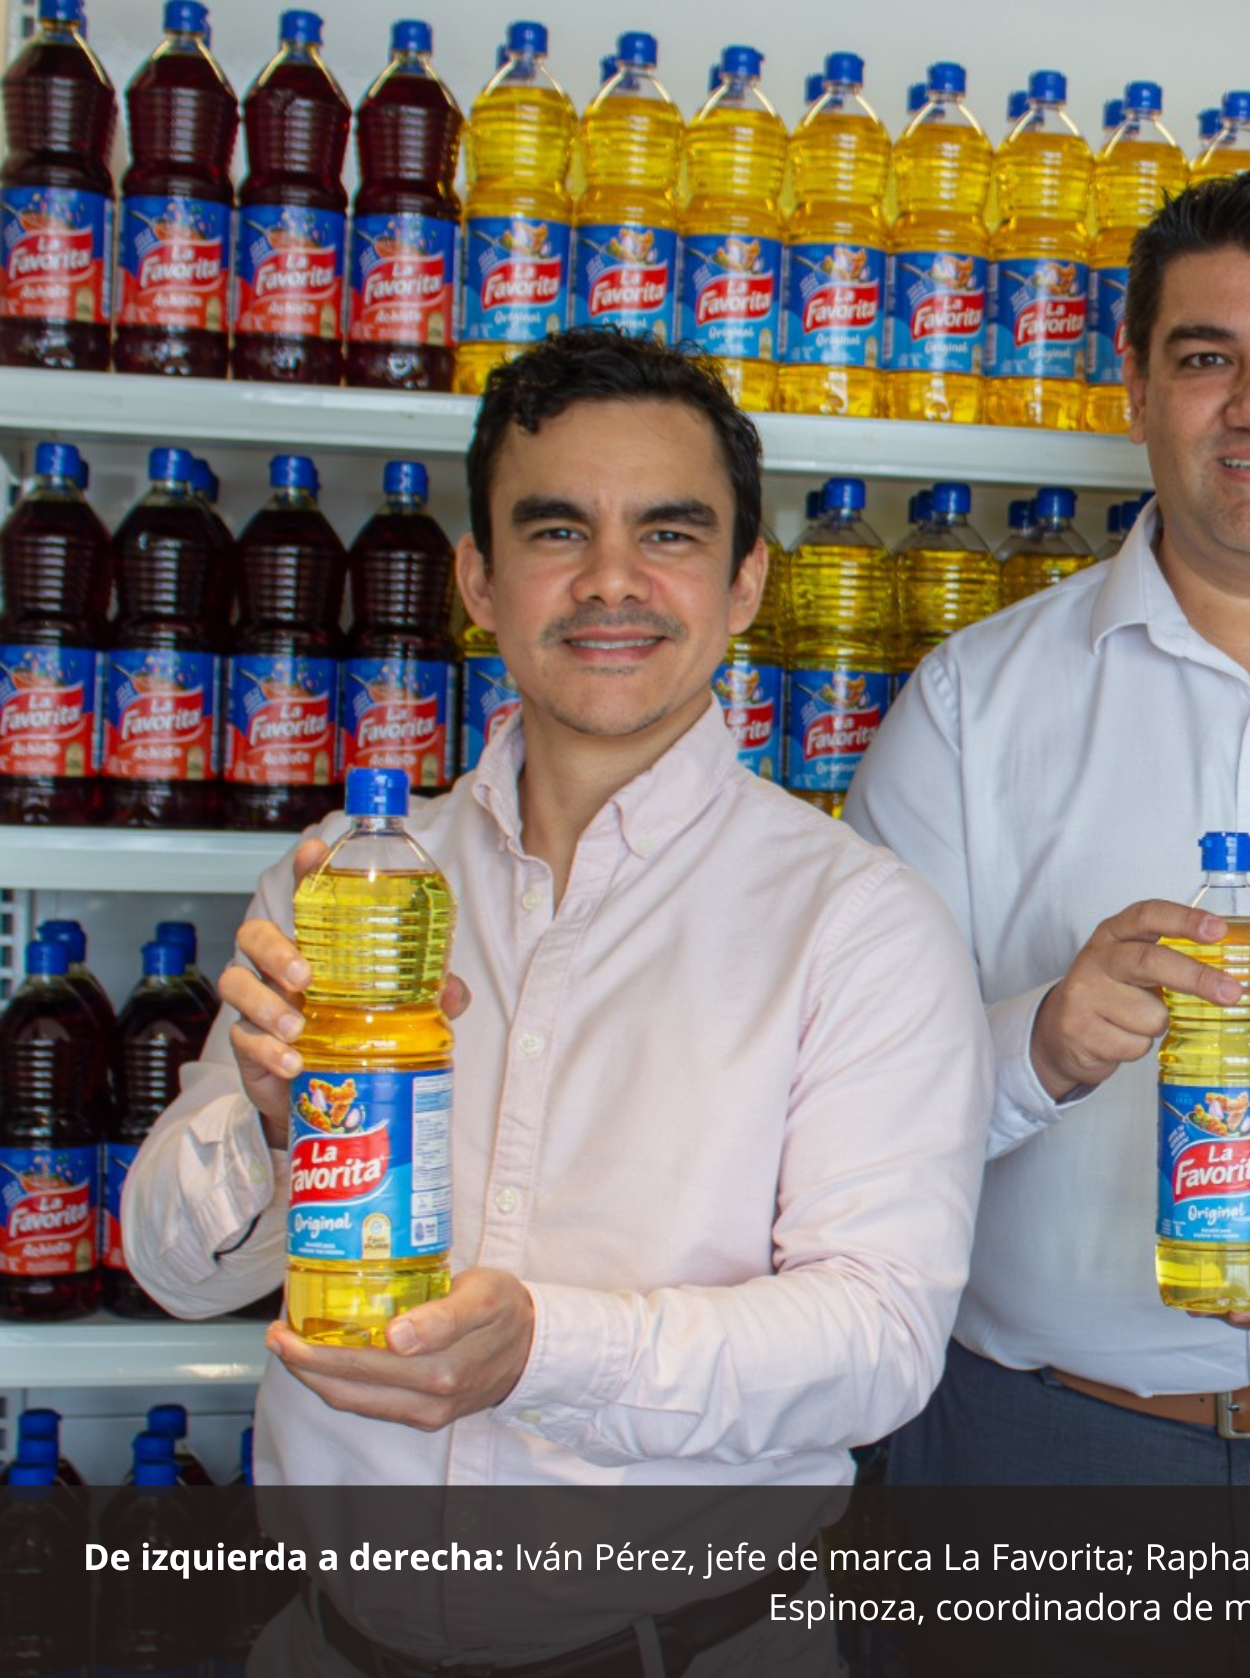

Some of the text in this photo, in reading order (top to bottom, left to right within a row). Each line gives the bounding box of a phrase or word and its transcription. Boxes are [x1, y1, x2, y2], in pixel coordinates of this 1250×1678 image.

[37, 236, 61, 251] La
[171, 244, 195, 260] La
[8, 248, 90, 280] Favorita
[139, 257, 220, 289] Favorita
[286, 254, 308, 270] La
[392, 263, 415, 277] La
[513, 264, 537, 280] La
[256, 267, 334, 297] Favorita
[620, 270, 643, 286] La
[727, 279, 748, 295] La
[364, 276, 441, 306] Favorita
[484, 273, 559, 306] Favorita
[591, 281, 665, 313] Favorita
[834, 287, 856, 303] La
[698, 291, 772, 321] Favorita
[805, 299, 877, 329] Favorita
[941, 296, 964, 310] La
[1046, 302, 1067, 317] La
[913, 307, 982, 338] Favorita
[1017, 313, 1085, 343] Favorita
[29, 695, 52, 710] La
[150, 700, 174, 714] La
[280, 705, 302, 719] La
[1, 706, 80, 736] Favorita
[121, 710, 201, 741] Favorita
[386, 709, 409, 722] La
[249, 716, 327, 746] Favorita
[357, 718, 434, 748] Favorita
[311, 1143, 337, 1164] La
[1209, 1145, 1233, 1163] La
[40, 1197, 63, 1211] La
[1188, 1202, 1246, 1226] Original
[9, 1203, 89, 1238] Favorita
[294, 1213, 352, 1239] Original
